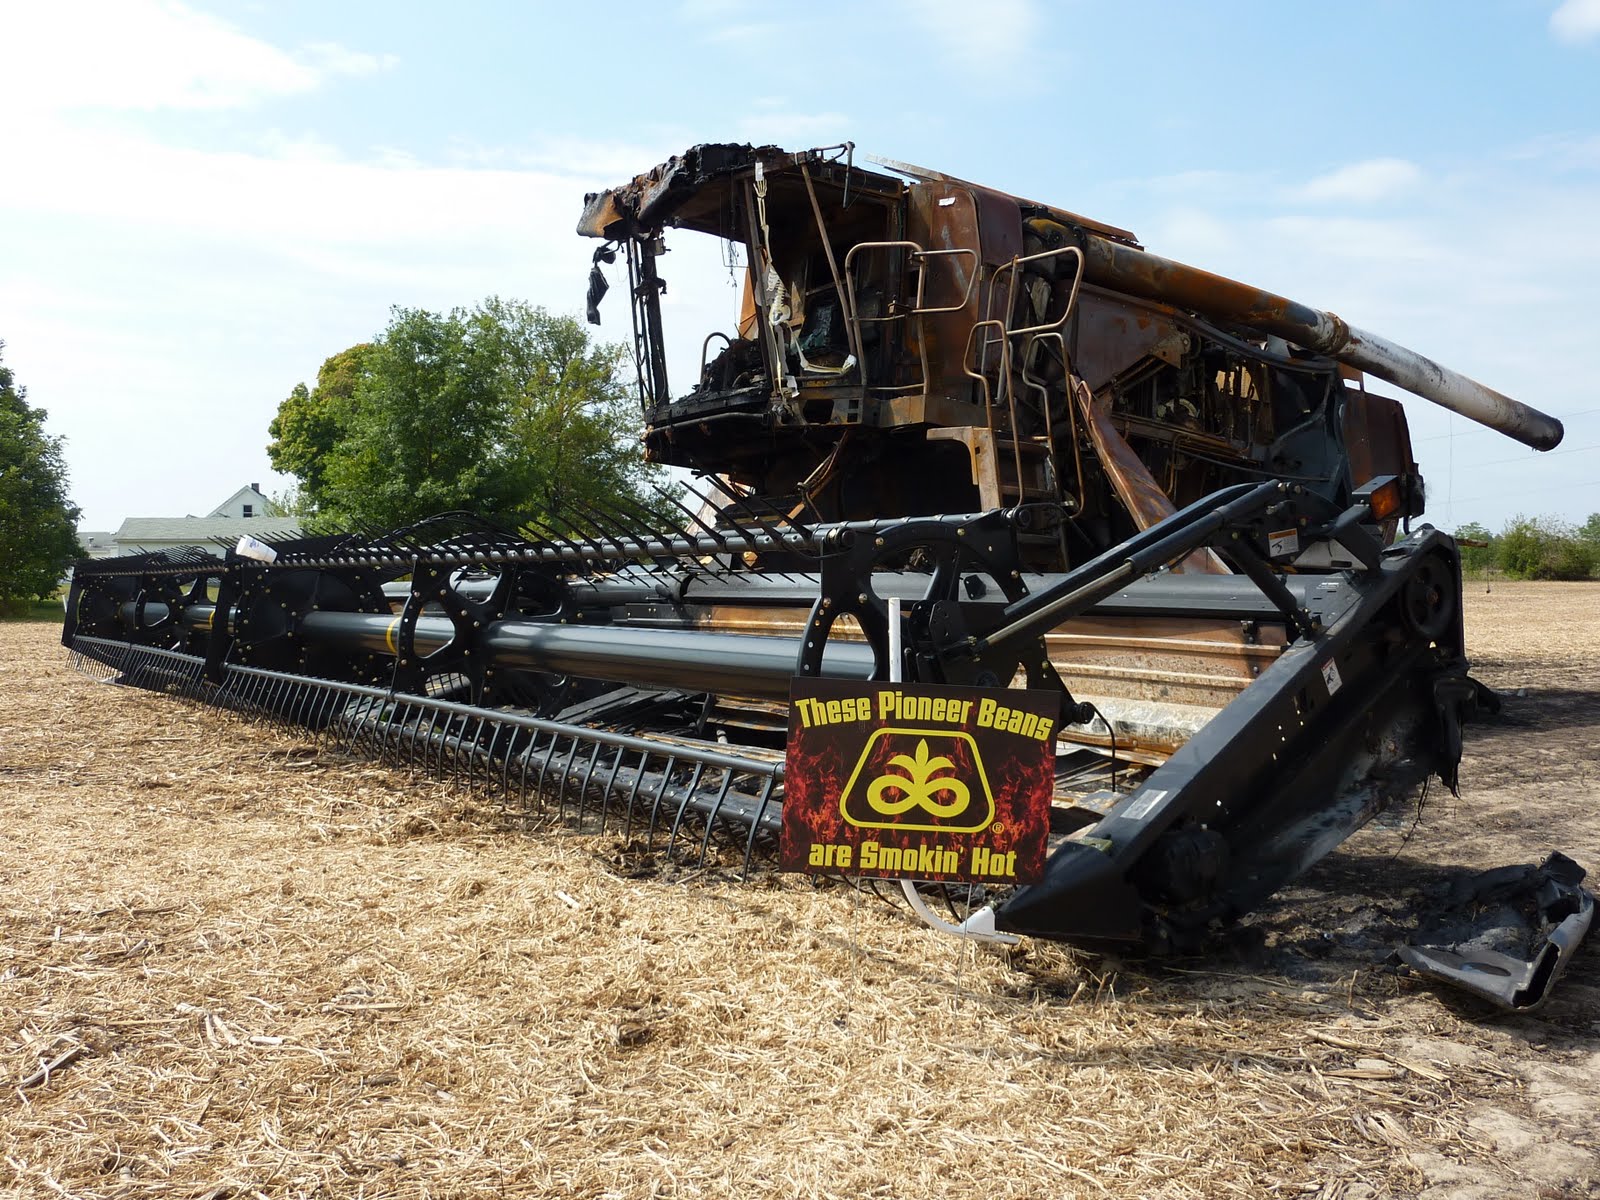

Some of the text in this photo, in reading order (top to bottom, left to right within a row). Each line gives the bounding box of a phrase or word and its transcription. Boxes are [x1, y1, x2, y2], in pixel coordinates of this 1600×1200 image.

[795, 691, 1054, 741] These Pioneer Beans
[808, 841, 1017, 877] are Smokin' Hot
